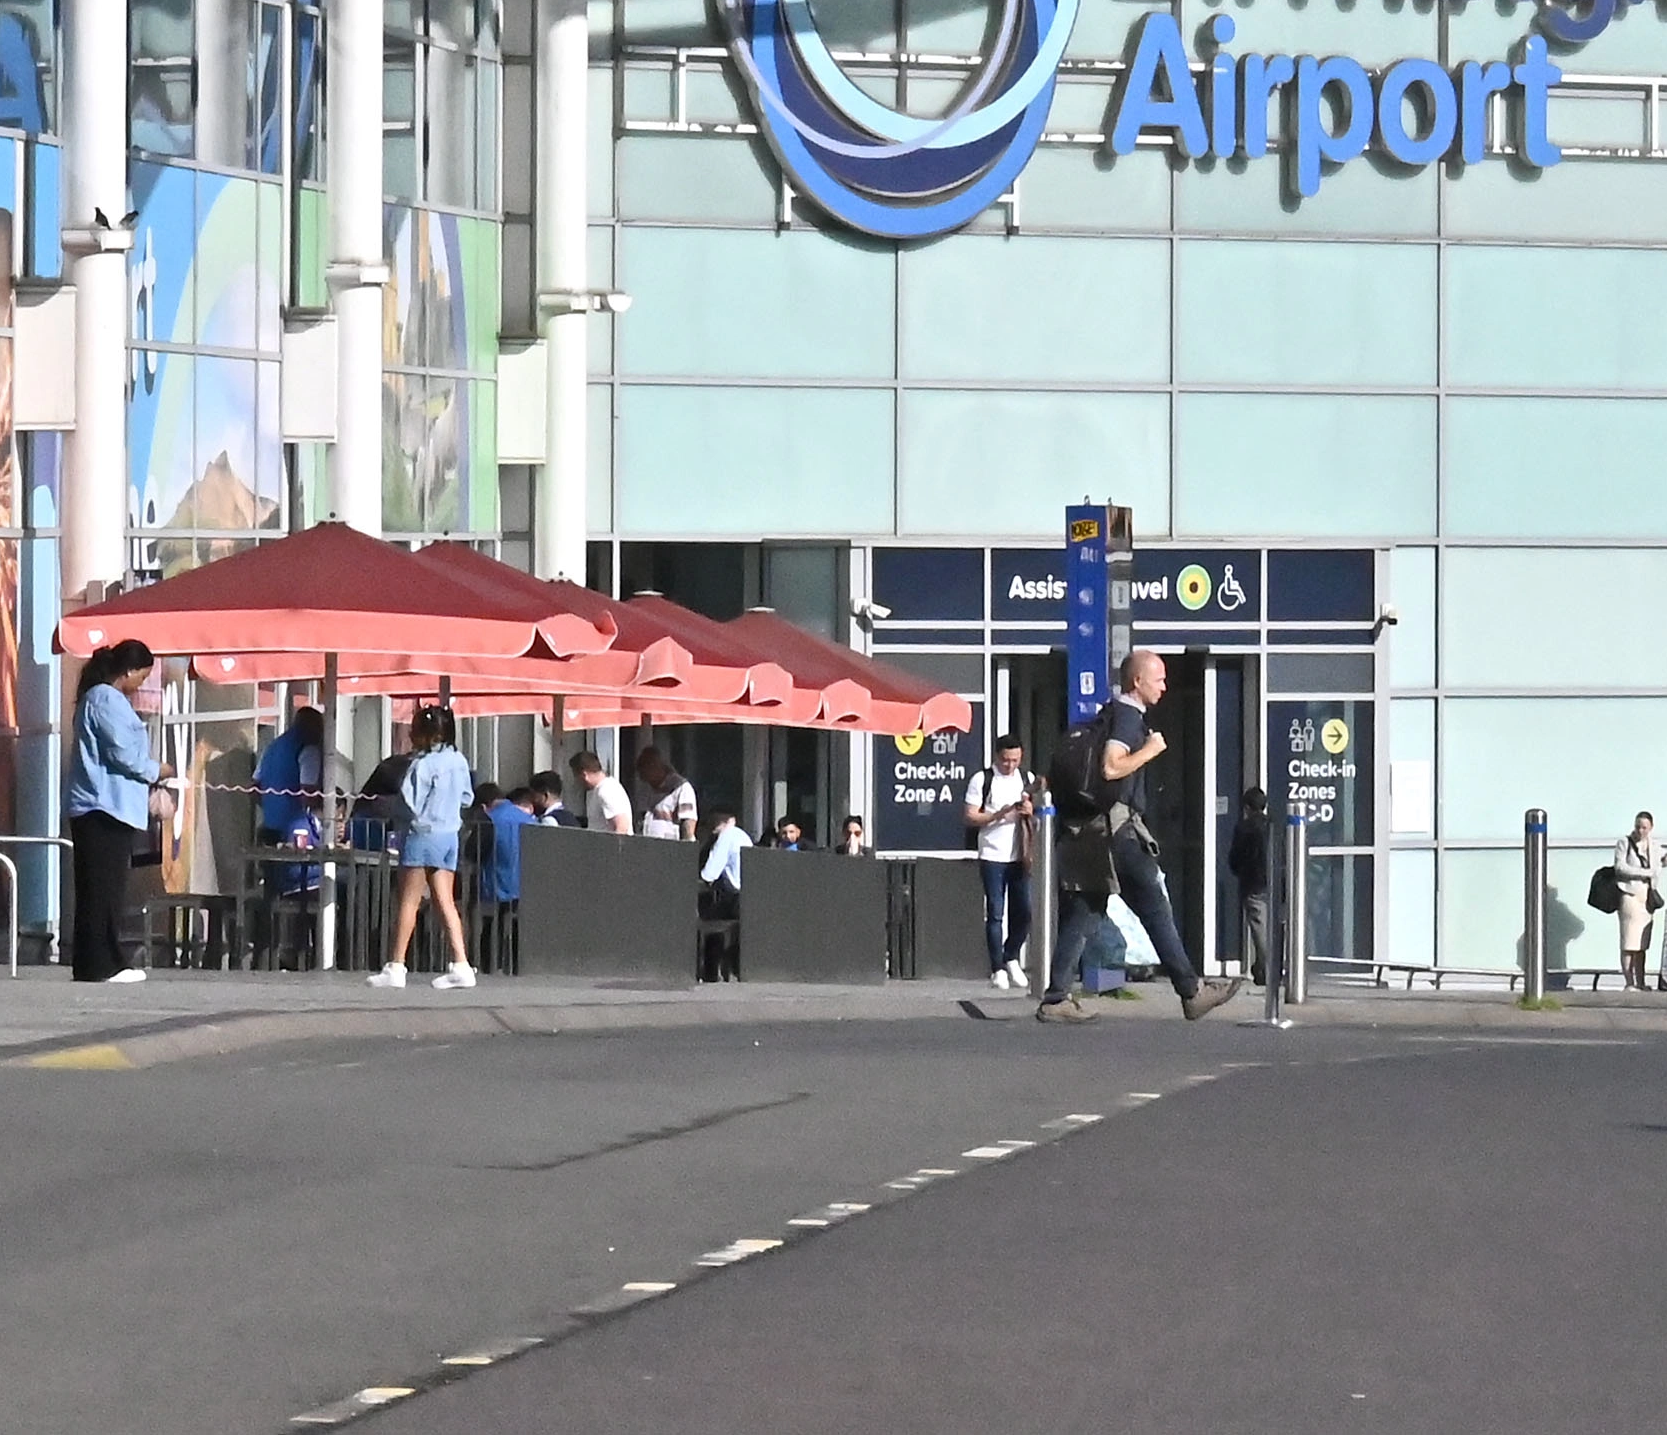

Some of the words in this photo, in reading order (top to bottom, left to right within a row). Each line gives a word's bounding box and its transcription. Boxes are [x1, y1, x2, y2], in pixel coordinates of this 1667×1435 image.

[1111, 12, 1562, 199] Airport
[1008, 574, 1068, 600] Assis
[894, 760, 966, 780] Check-in
[1288, 758, 1356, 778] Check-in
[894, 784, 936, 803] Zone
[939, 784, 953, 803] A
[1288, 781, 1337, 800] Zones
